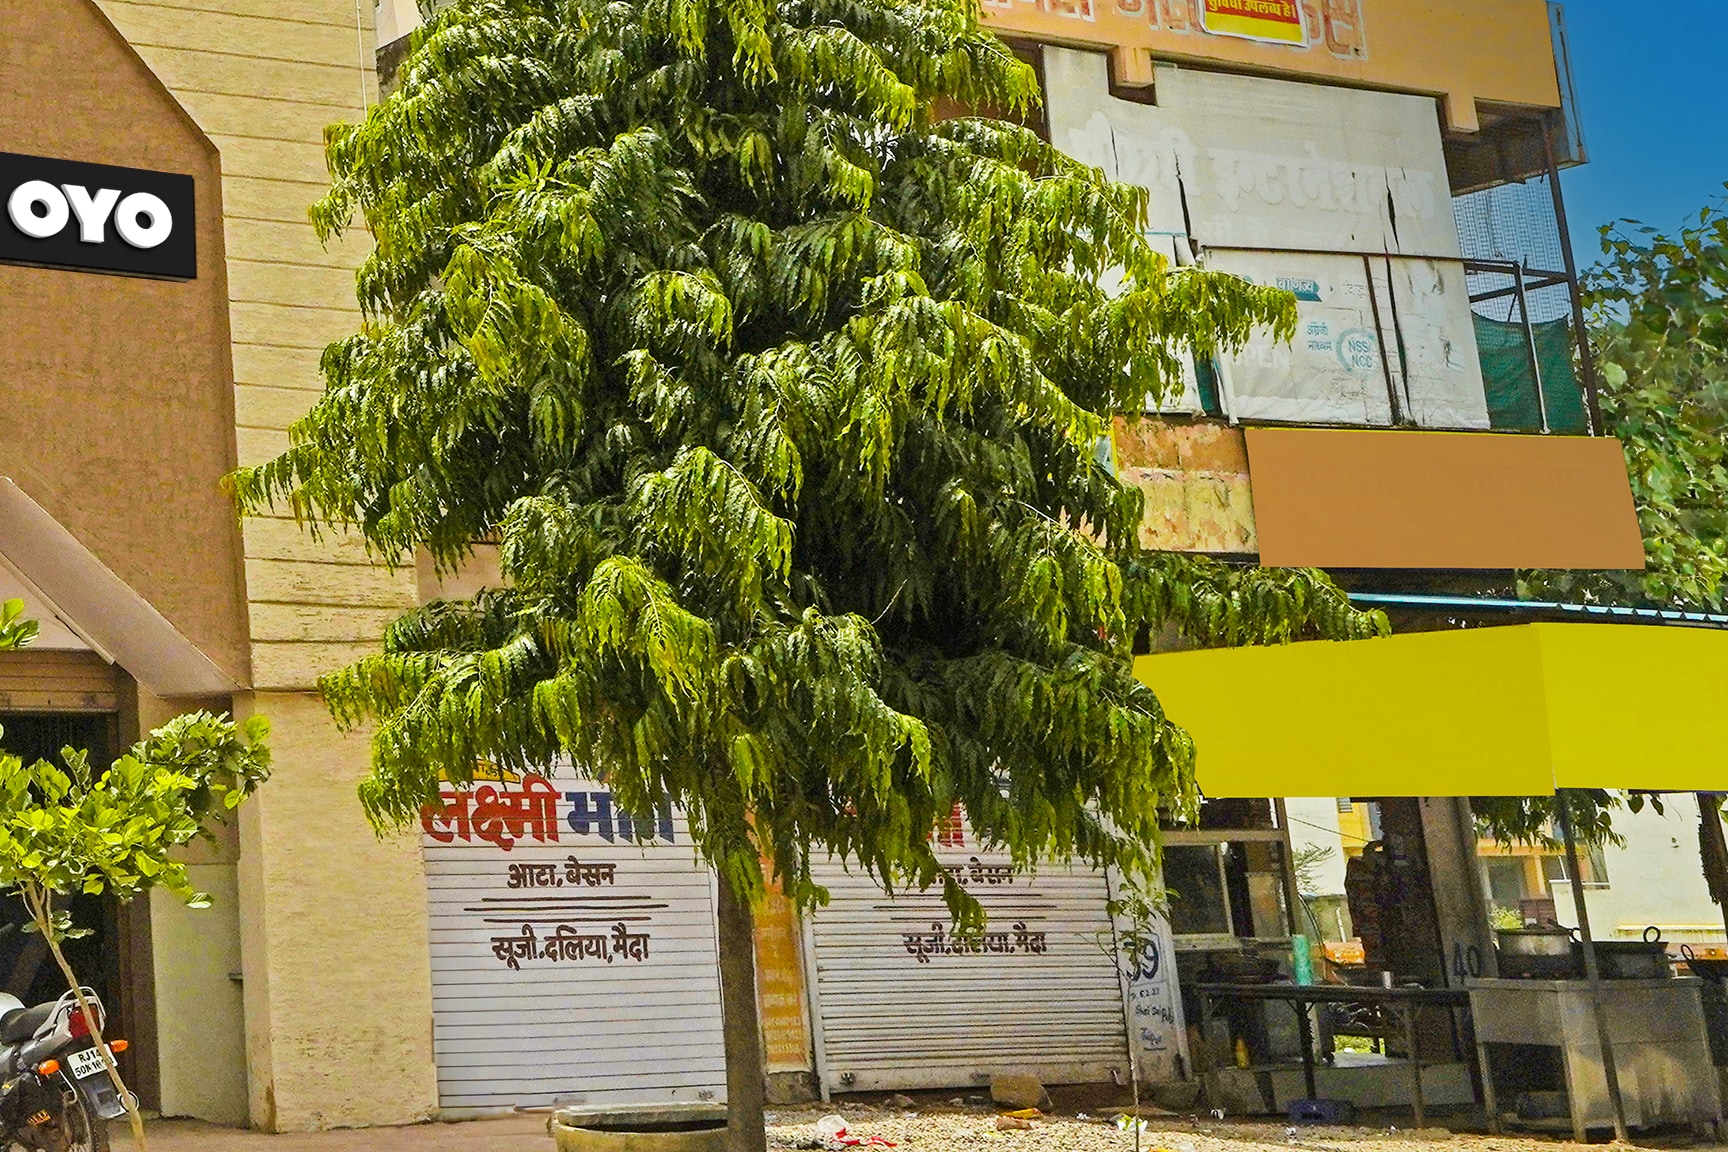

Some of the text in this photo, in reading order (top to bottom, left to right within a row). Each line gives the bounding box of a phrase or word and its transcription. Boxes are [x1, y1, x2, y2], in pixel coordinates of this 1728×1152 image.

[7, 179, 173, 249] OYO
[1348, 339, 1370, 354] NSS
[564, 855, 617, 887] बेसन
